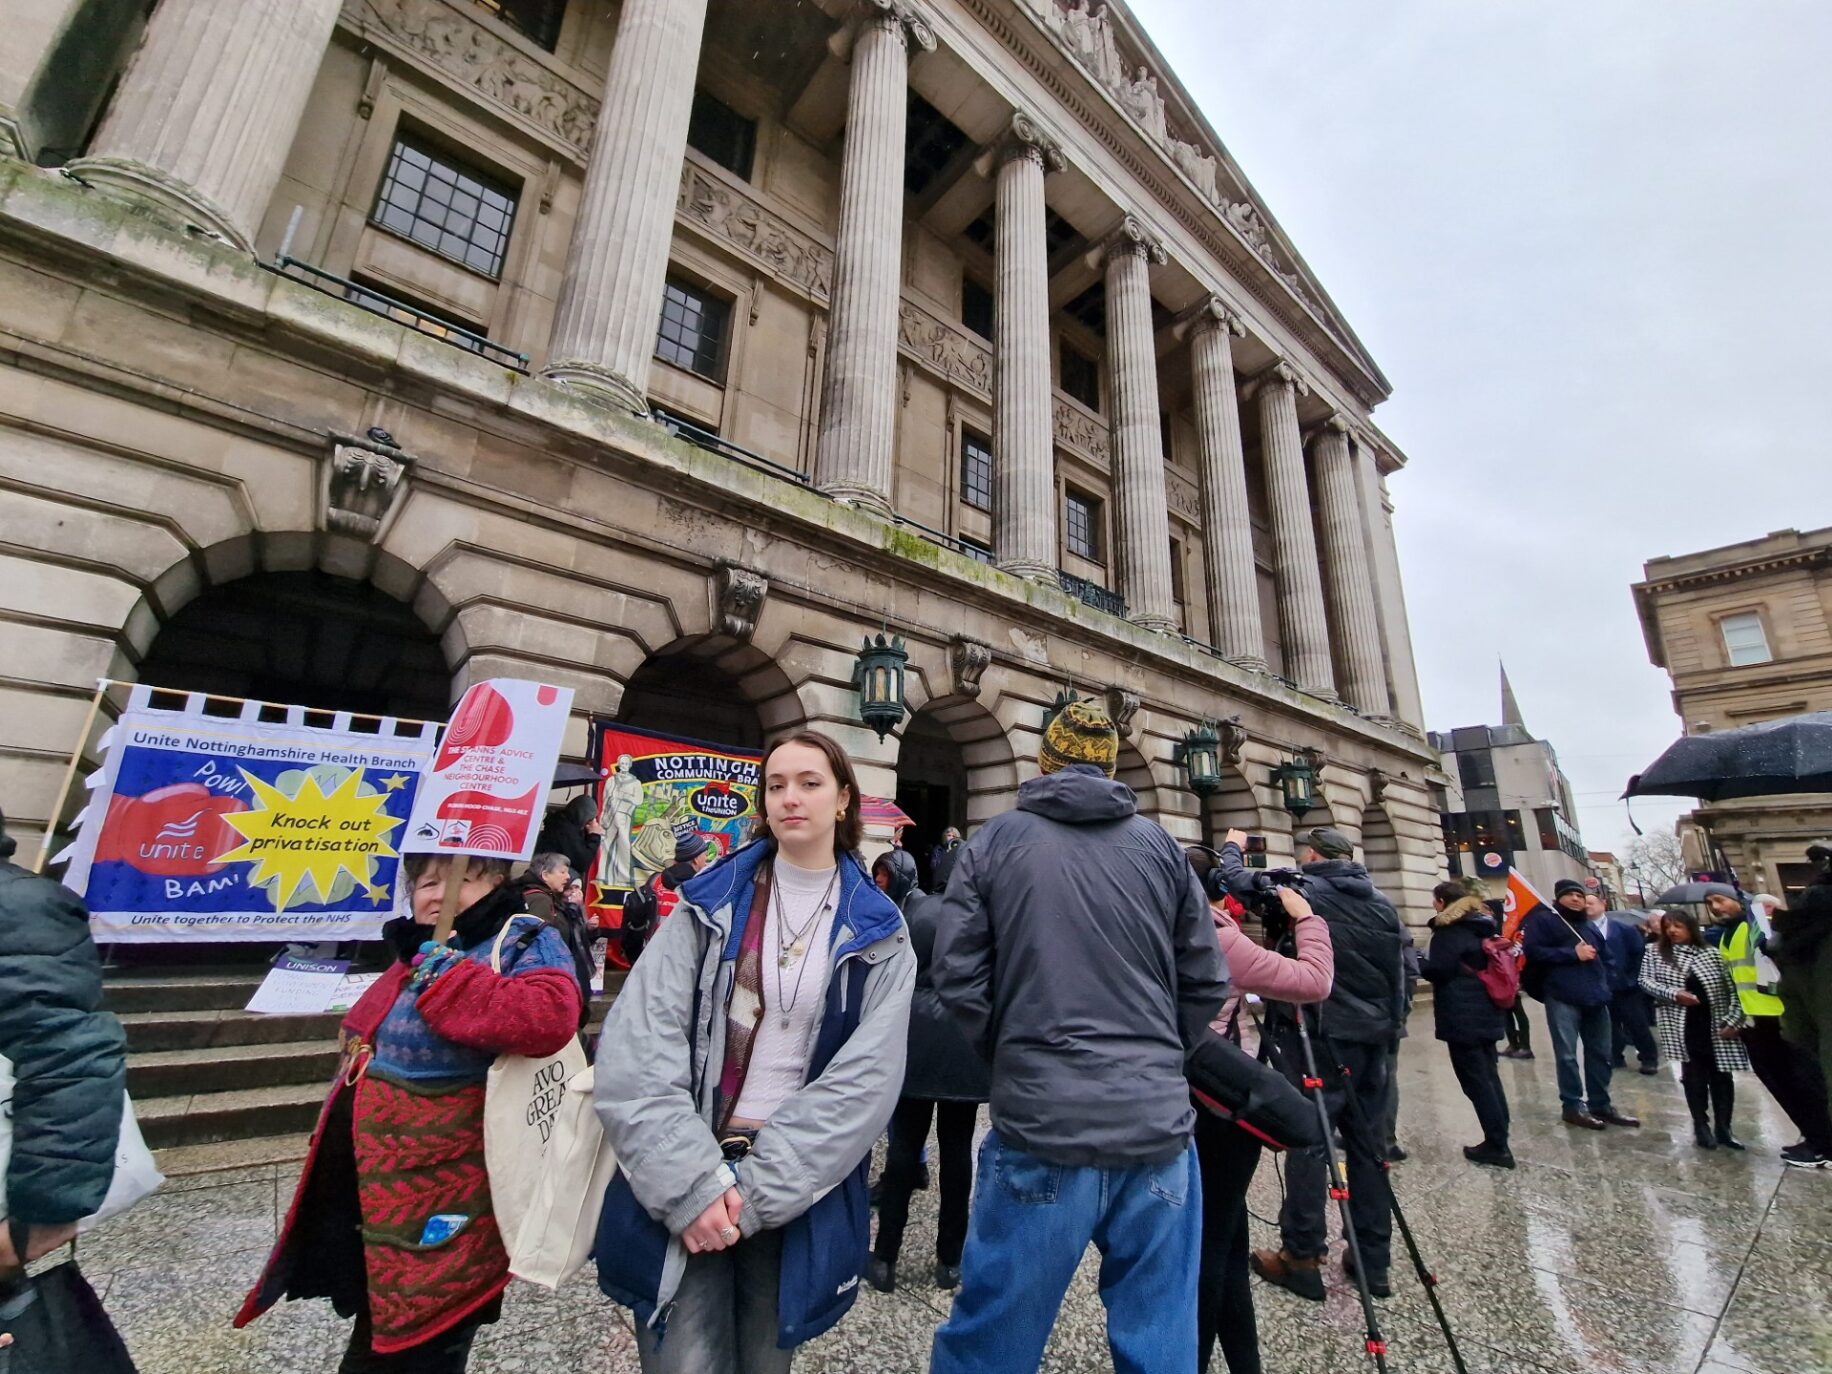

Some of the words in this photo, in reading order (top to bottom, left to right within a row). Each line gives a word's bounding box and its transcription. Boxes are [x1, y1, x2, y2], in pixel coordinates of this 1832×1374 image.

[134, 732, 181, 747] Unite
[186, 738, 316, 760] Nottinghamshire
[321, 752, 367, 765] Health
[371, 756, 416, 768] Branch
[500, 749, 535, 759] ADVICE
[464, 755, 495, 763] CENTRE
[475, 764, 505, 773] CHASE
[654, 756, 760, 777] NOTTINGH
[444, 773, 519, 785] NEIGHBOURHOOD
[657, 769, 732, 781] COMMUNITY
[460, 782, 492, 791] CENTRE
[271, 812, 331, 829] Knock
[339, 819, 371, 831] out
[249, 835, 379, 853] privatisation
[131, 915, 170, 925] Unite
[174, 915, 233, 926] together
[237, 915, 250, 924] to
[253, 915, 299, 924] Protect
[302, 915, 323, 924] the
[325, 914, 351, 923] NHS
[286, 961, 337, 972] UNISON
[526, 1074, 576, 1126] GREA
